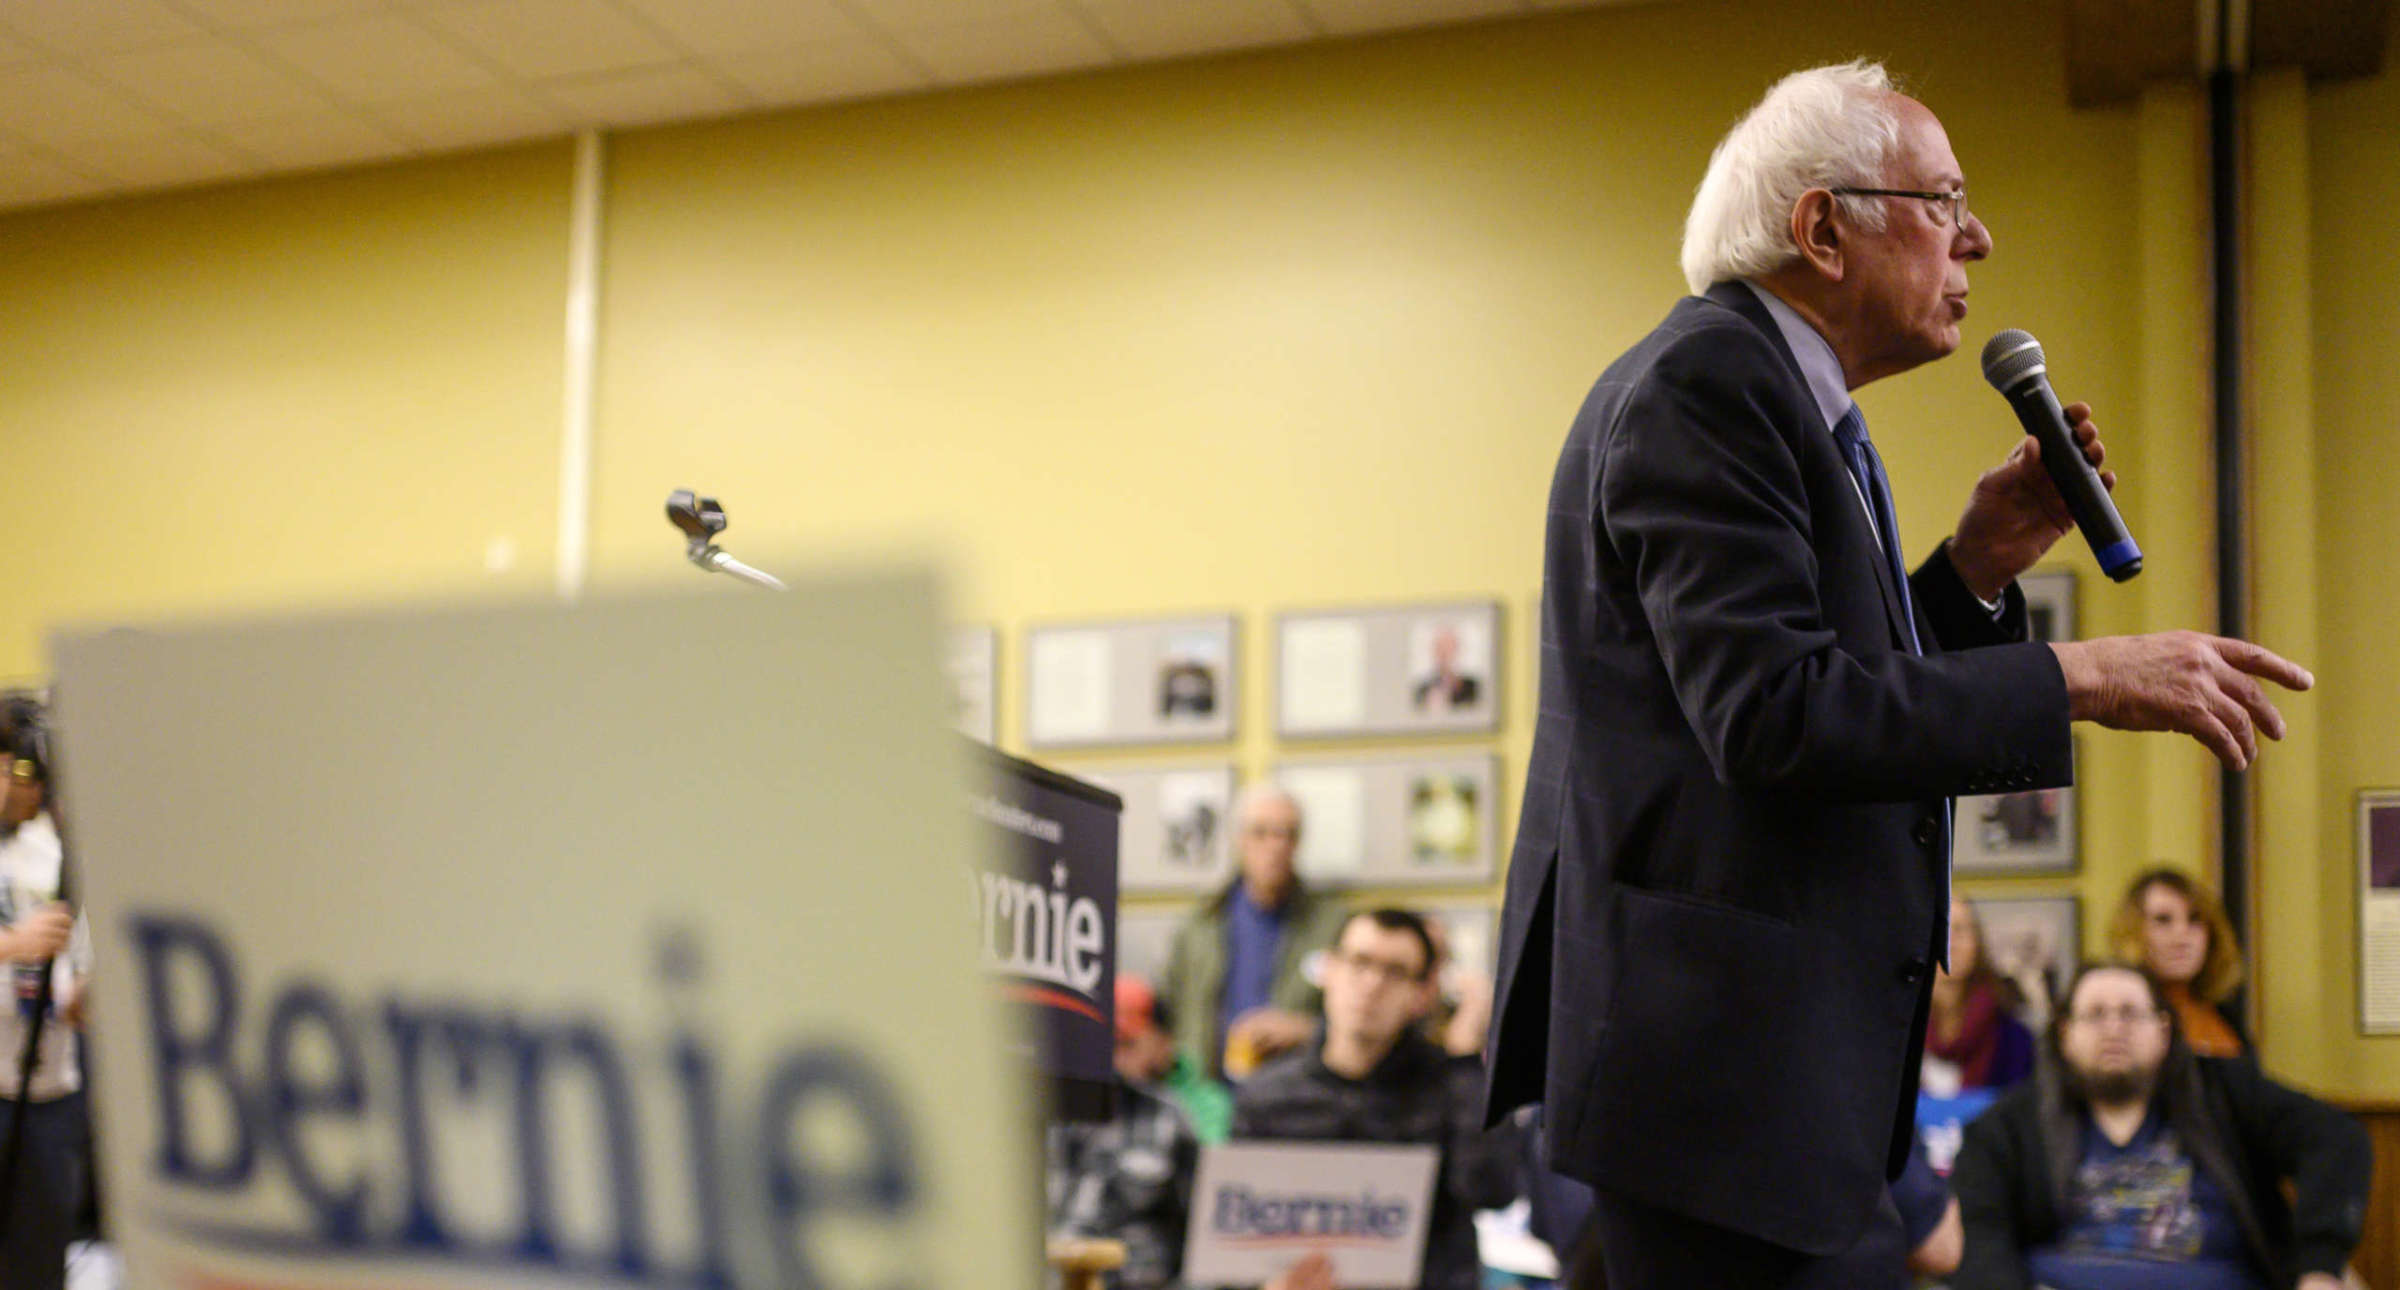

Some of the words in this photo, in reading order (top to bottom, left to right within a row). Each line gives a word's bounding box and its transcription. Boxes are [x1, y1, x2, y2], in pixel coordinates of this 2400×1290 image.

[970, 858, 1103, 995] rnie
[125, 908, 922, 1289] Bernie
[1214, 1183, 1408, 1237] Bernie
